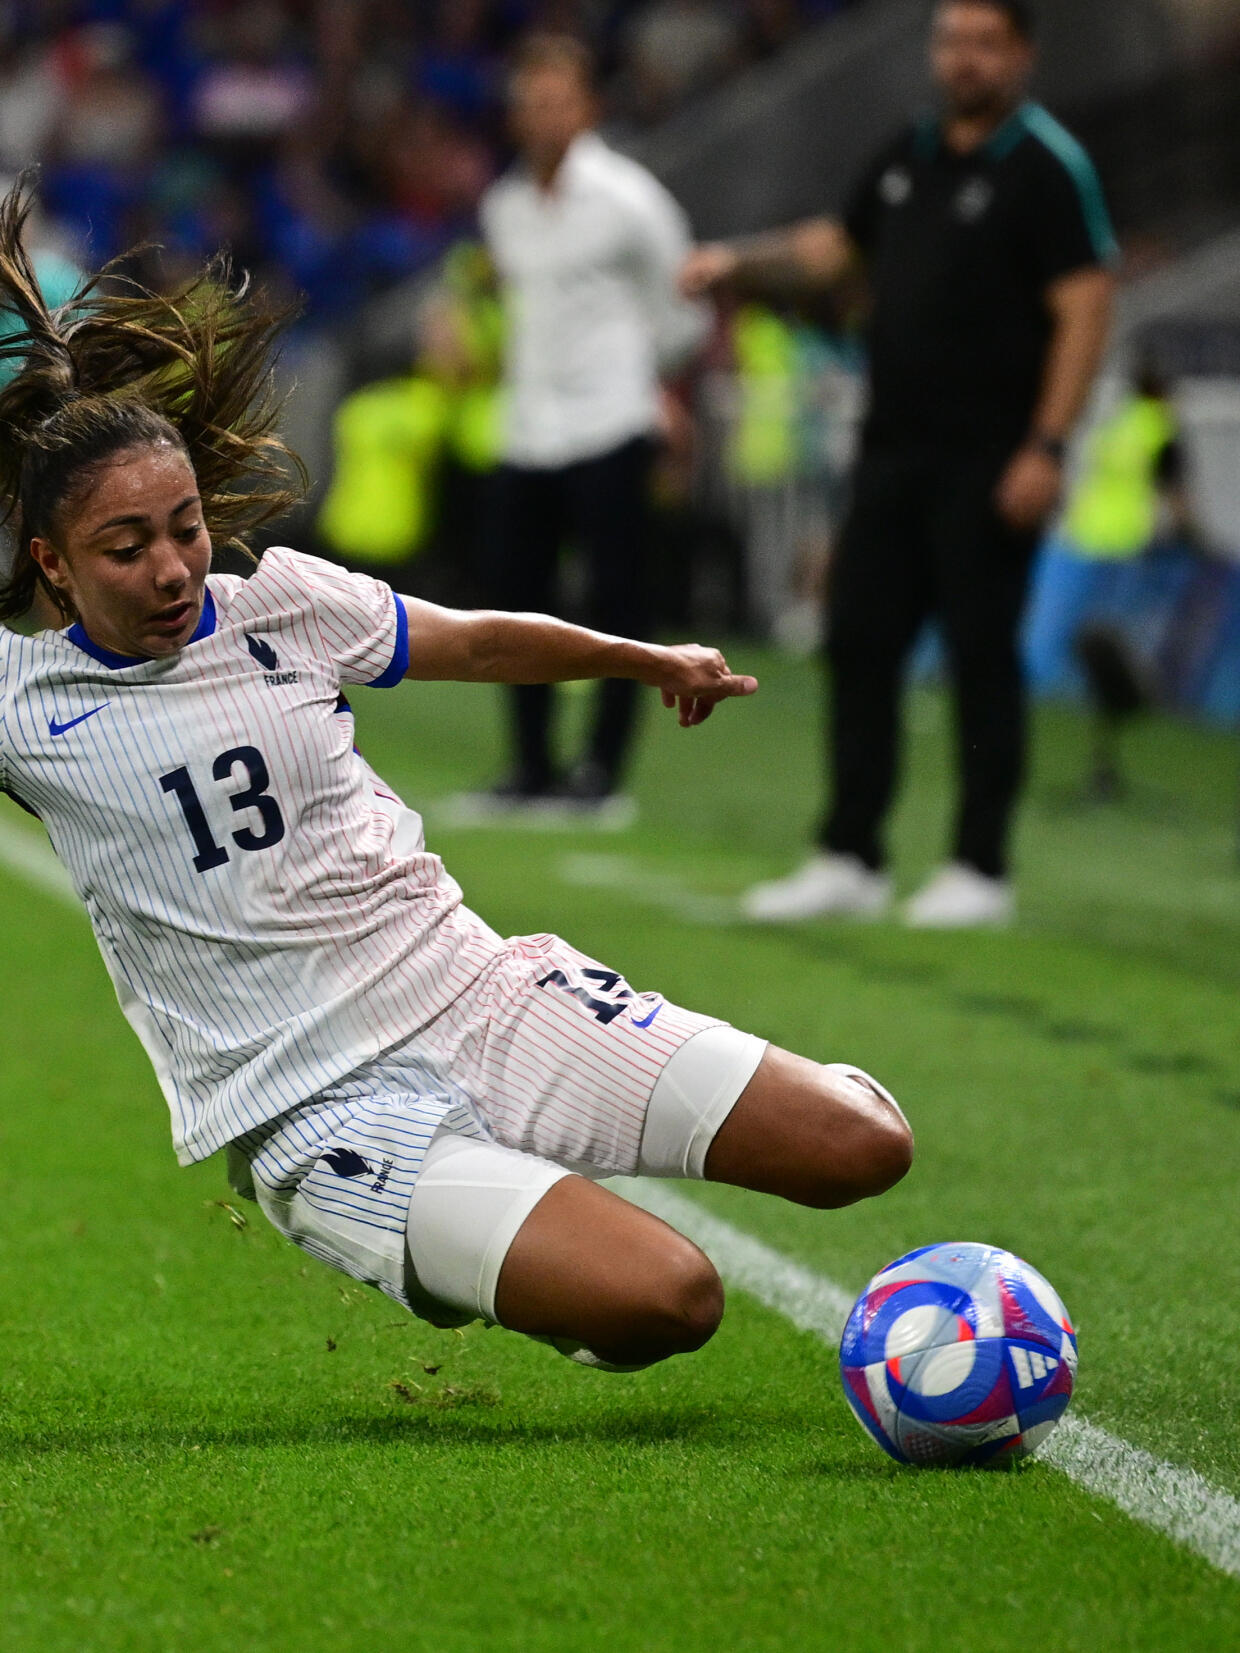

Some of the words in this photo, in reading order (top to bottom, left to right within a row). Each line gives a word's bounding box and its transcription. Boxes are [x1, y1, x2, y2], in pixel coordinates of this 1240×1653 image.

[264, 671, 298, 687] FRANCE
[159, 745, 286, 873] 13
[370, 1157, 394, 1195] FRANCE
